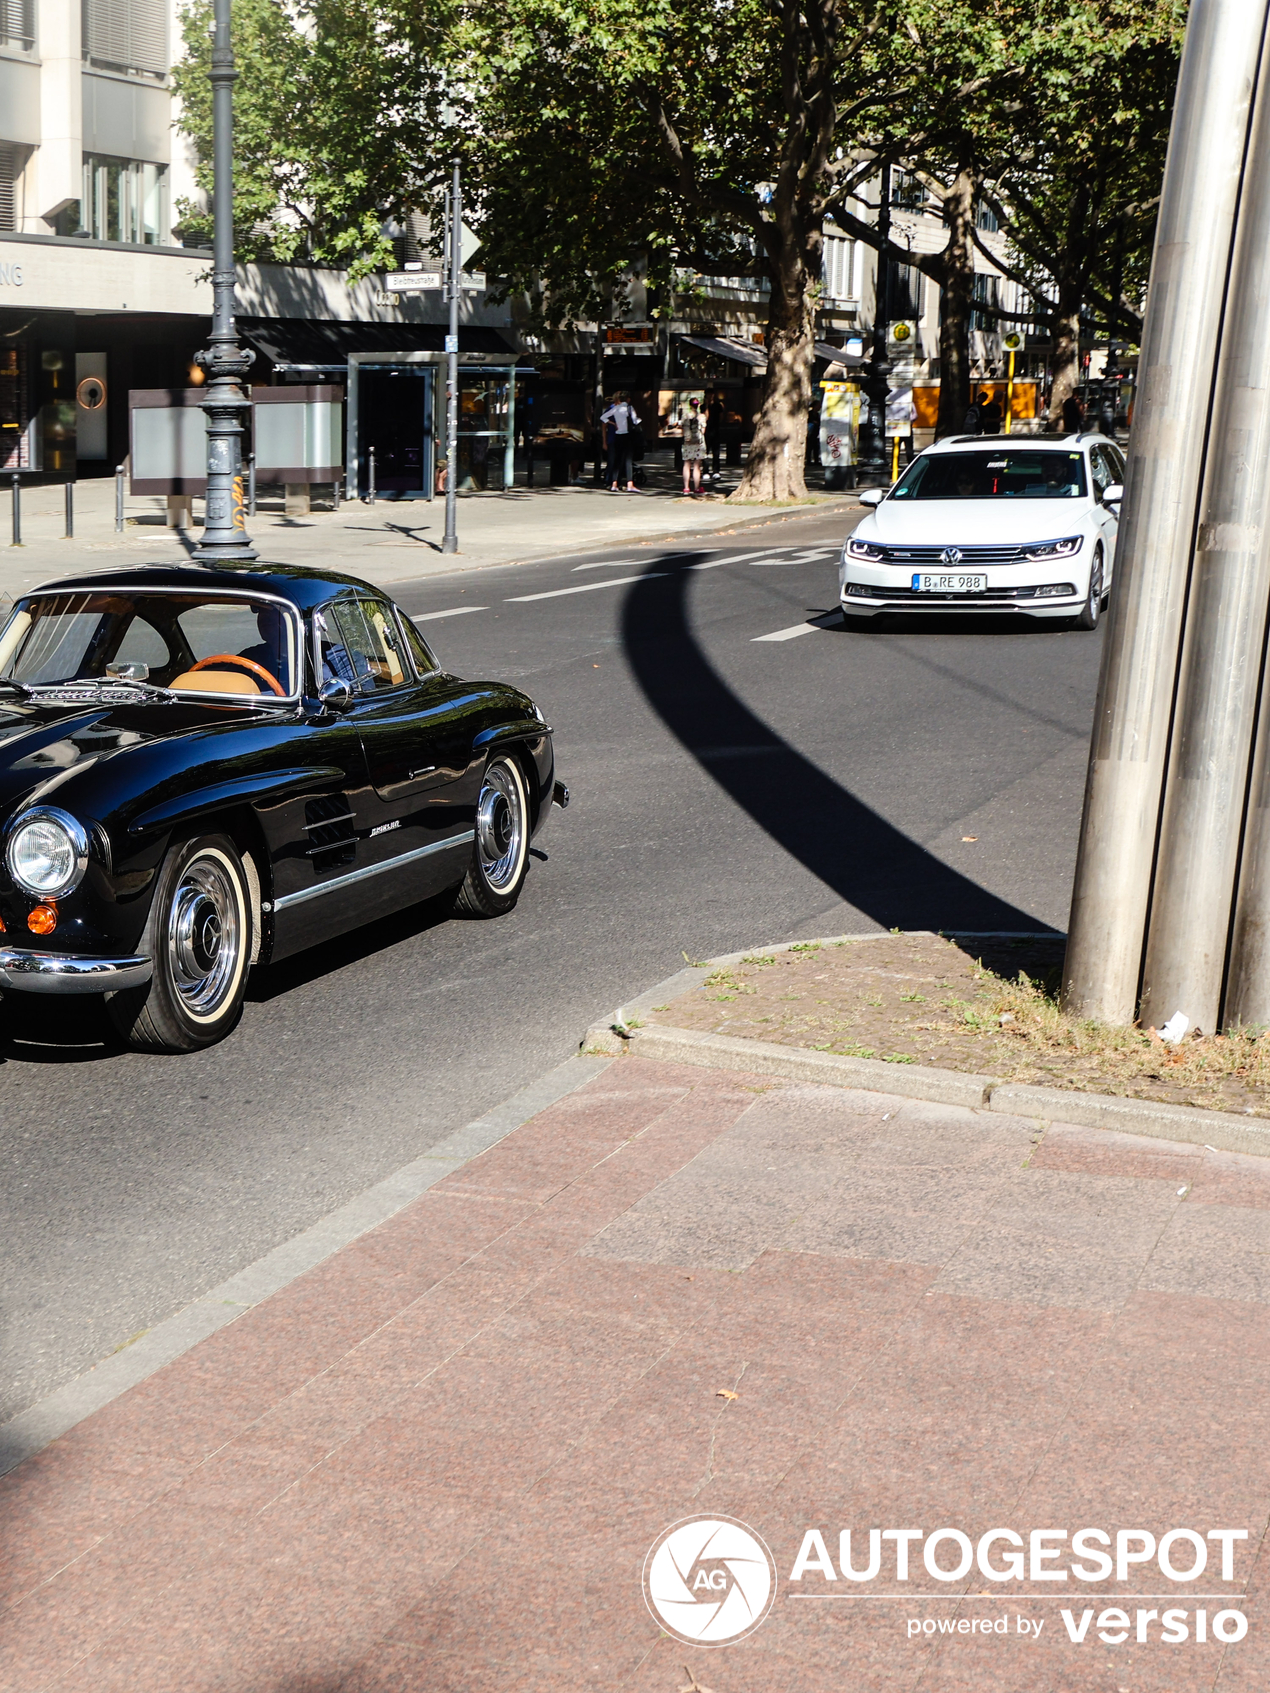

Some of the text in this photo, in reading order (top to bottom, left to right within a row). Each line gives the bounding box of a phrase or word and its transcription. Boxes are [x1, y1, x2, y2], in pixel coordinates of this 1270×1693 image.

[924, 576, 981, 588] B RE 988
